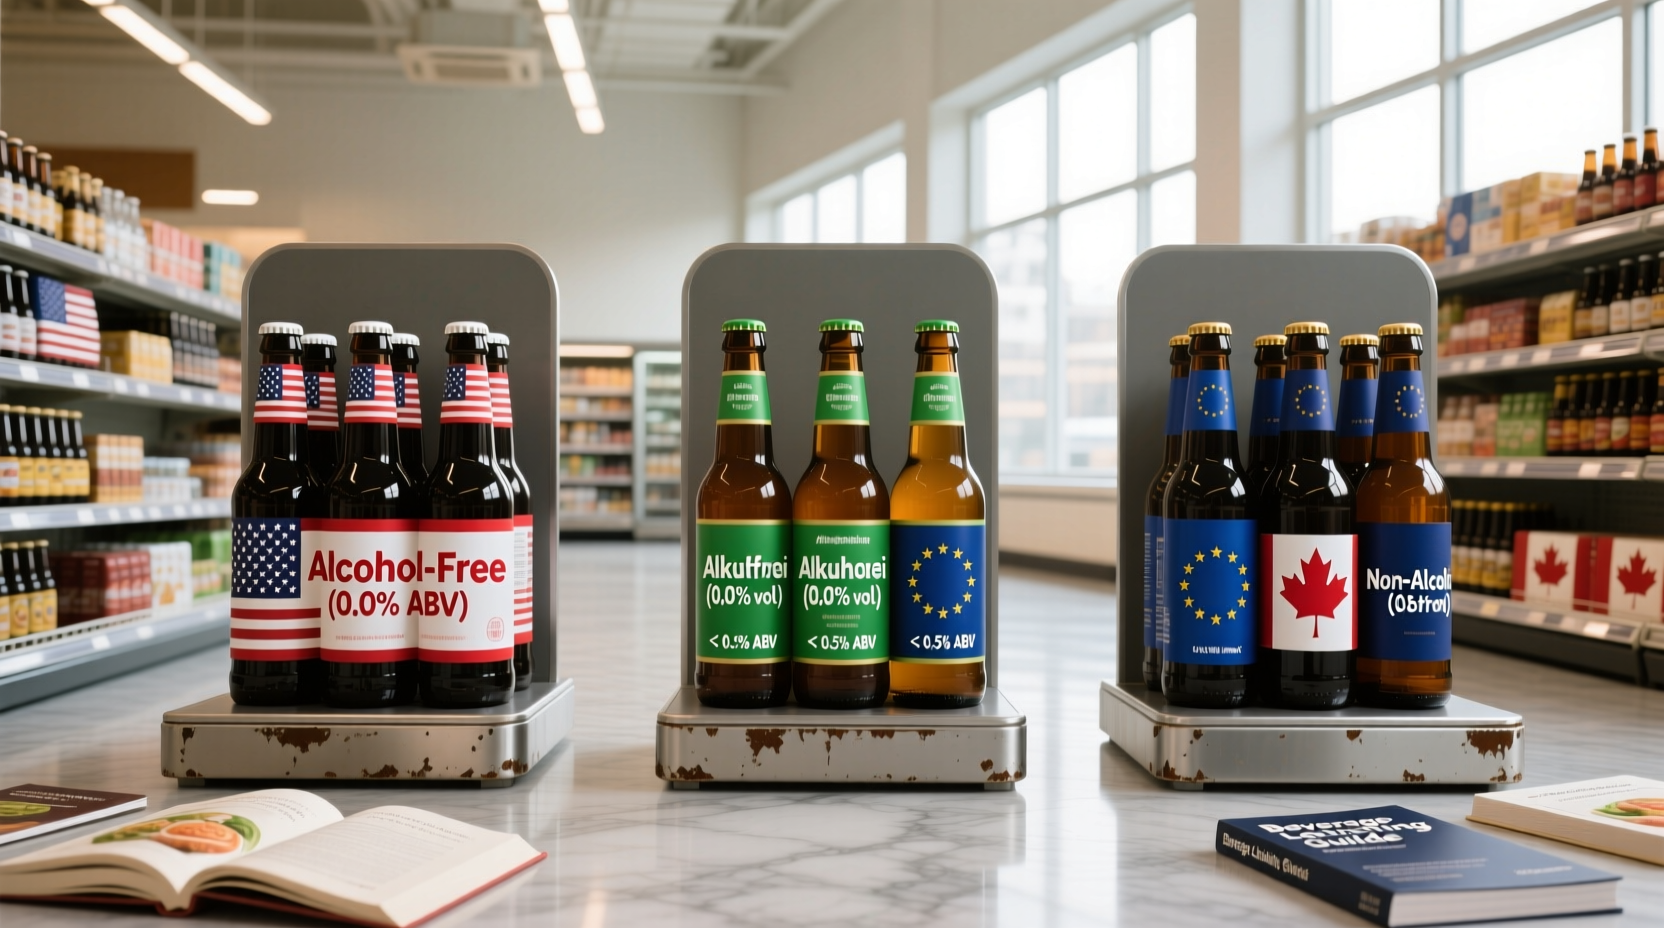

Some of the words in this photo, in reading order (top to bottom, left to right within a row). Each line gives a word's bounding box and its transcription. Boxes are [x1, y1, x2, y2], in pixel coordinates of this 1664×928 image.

[307, 550, 506, 583] Alcohol-Free
[328, 589, 400, 621] (0.0%
[406, 590, 469, 623] ABV)
[754, 584, 783, 609] vol)
[853, 584, 882, 610] vol)
[752, 634, 778, 649] ABV
[852, 634, 877, 650] ABV
[953, 633, 976, 649] ABV
